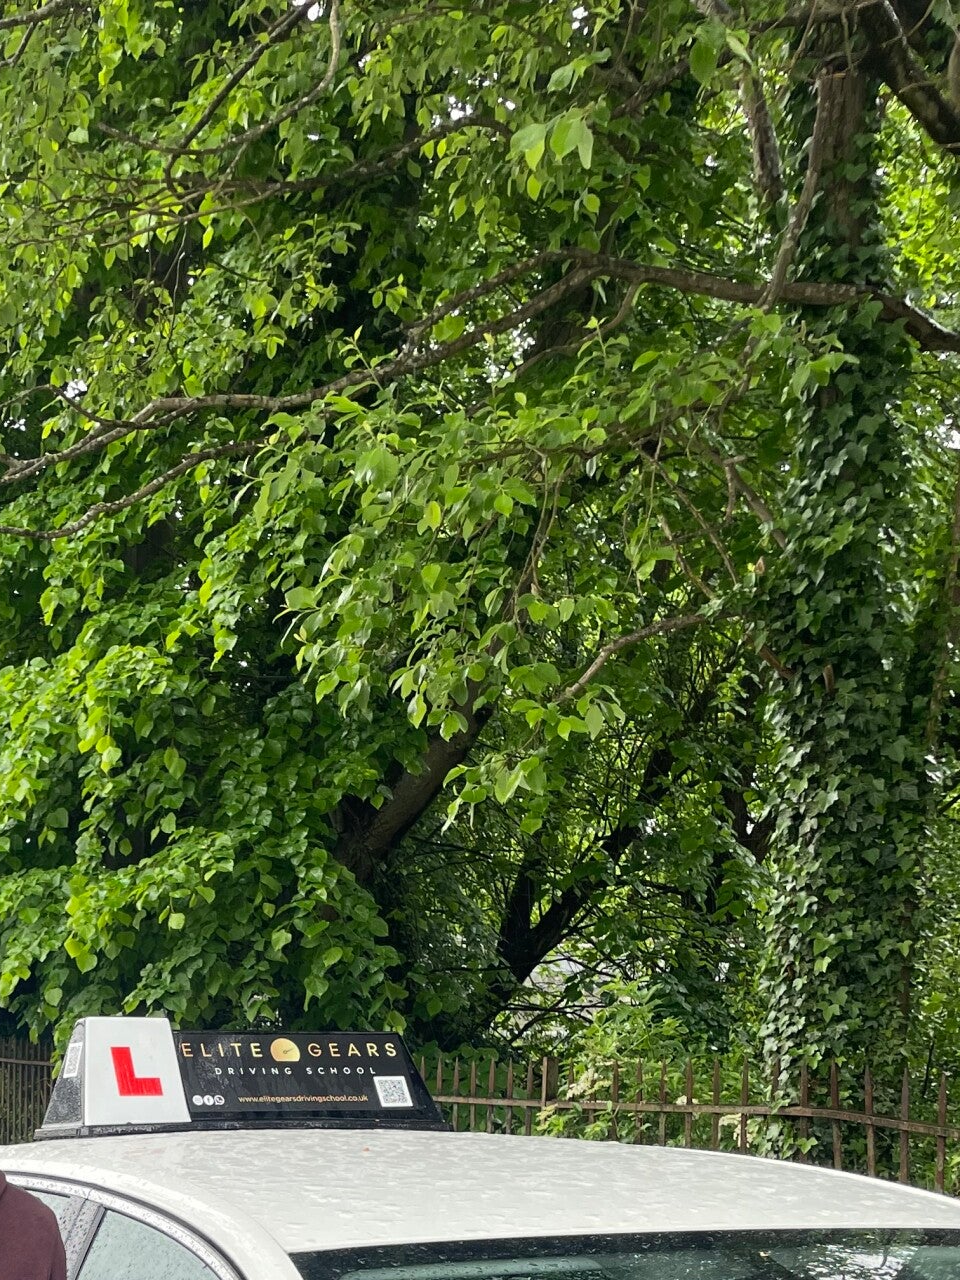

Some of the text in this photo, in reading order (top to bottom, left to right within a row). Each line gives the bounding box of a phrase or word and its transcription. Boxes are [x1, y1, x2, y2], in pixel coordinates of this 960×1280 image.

[182, 1042, 397, 1058] ELITE GEARS
[110, 1047, 163, 1096] L
[214, 1067, 376, 1076] DRIVING SCHOOL
[238, 1094, 368, 1104] www.elitegearsdrivingschool.co.uk
